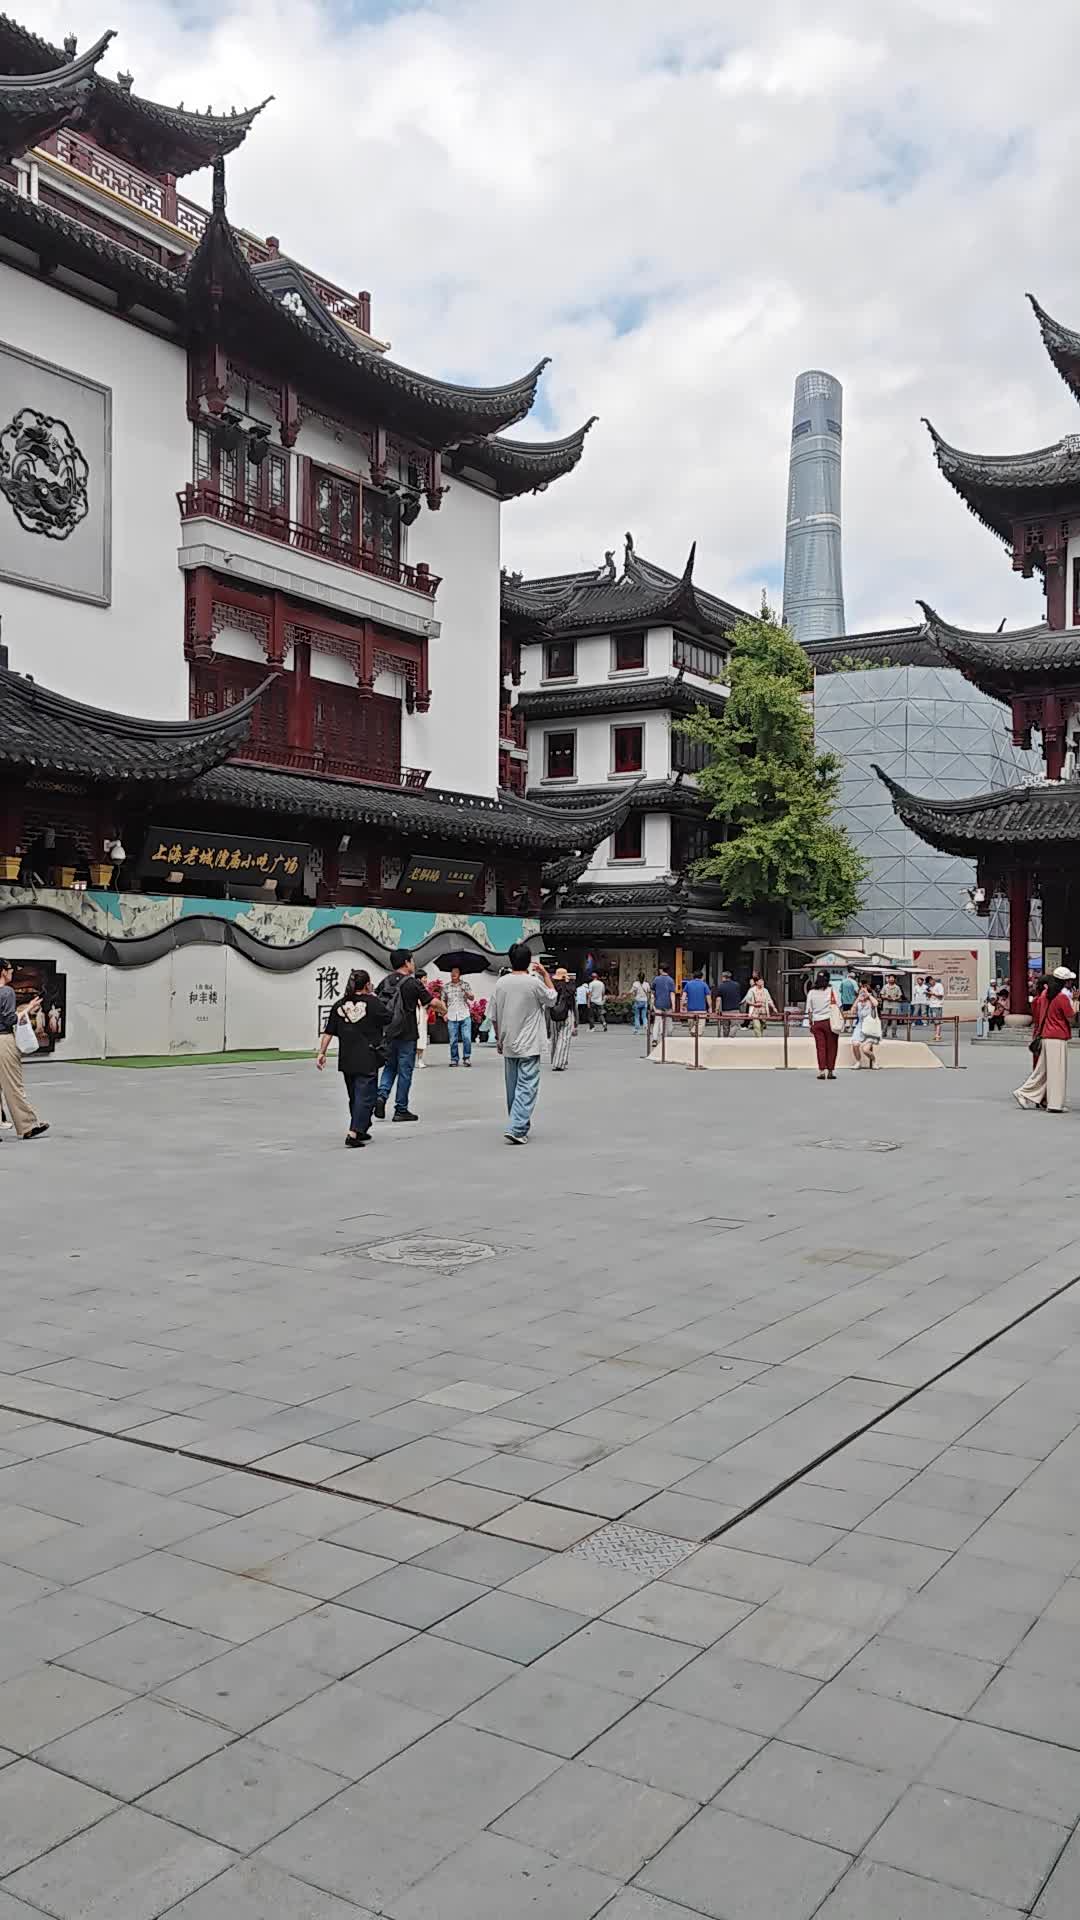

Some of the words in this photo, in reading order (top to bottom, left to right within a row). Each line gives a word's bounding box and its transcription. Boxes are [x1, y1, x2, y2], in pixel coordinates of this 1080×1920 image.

[151, 843, 299, 874] 上海老城隍庙小吃广场
